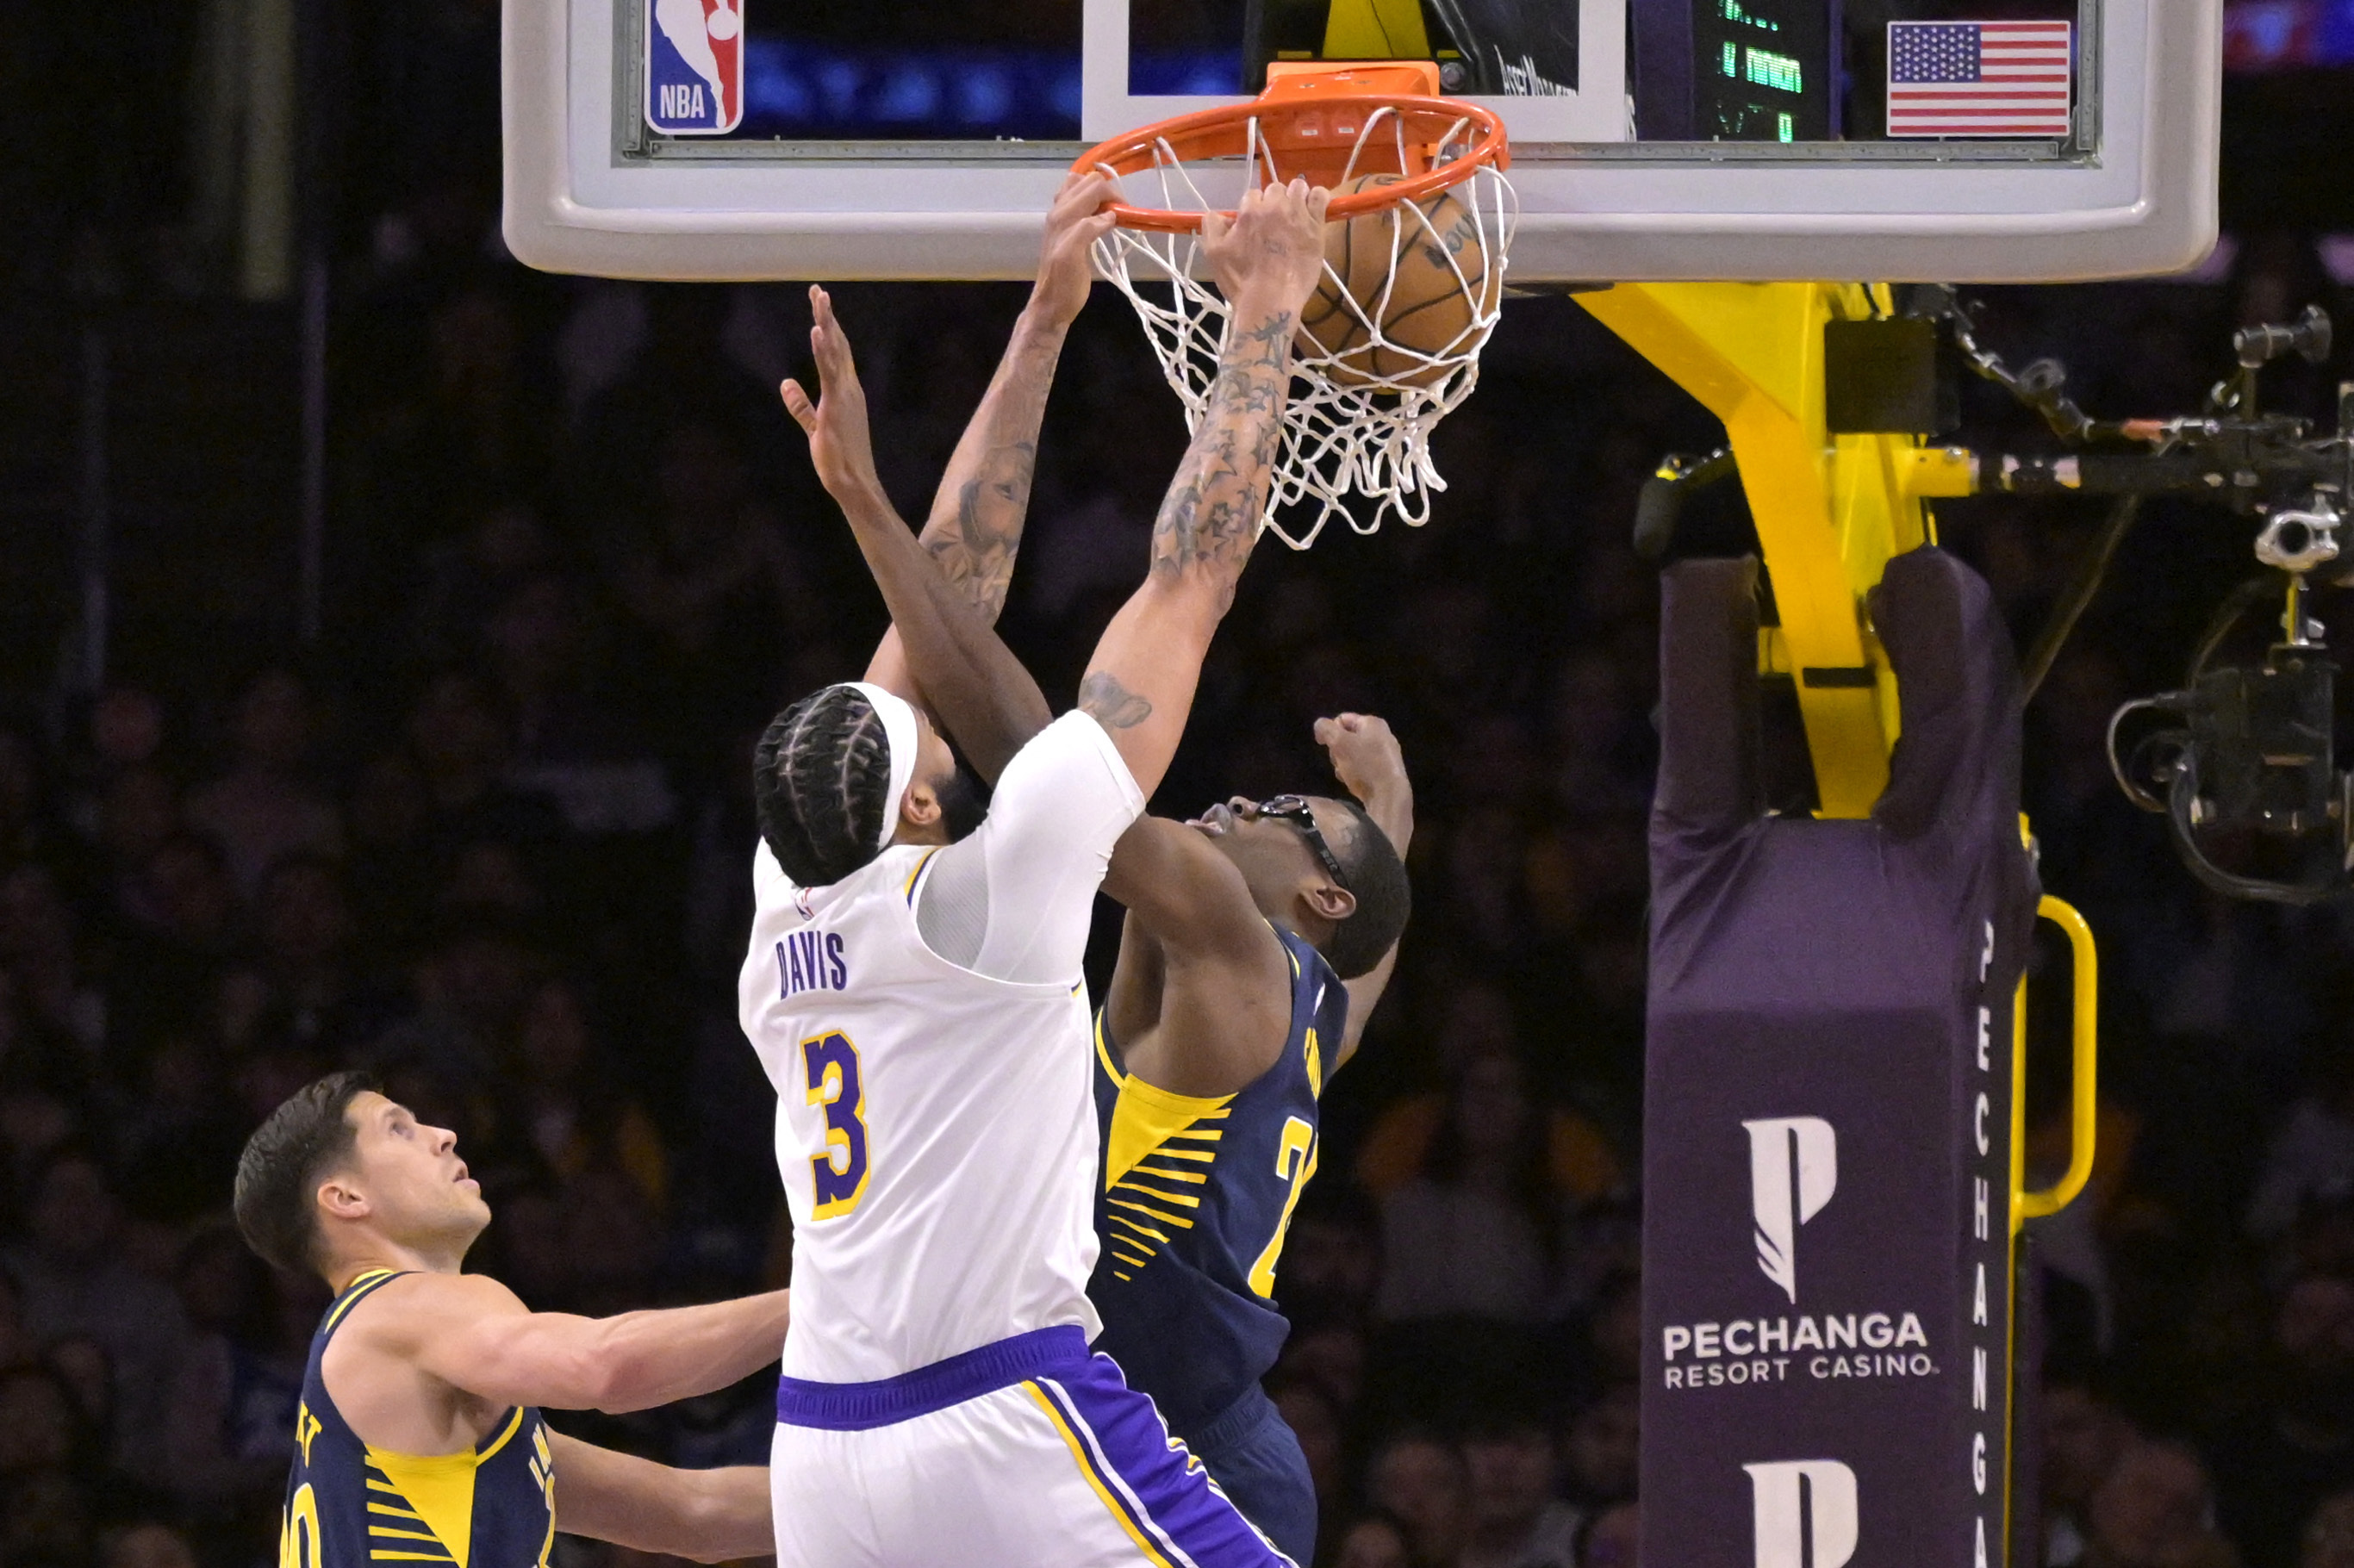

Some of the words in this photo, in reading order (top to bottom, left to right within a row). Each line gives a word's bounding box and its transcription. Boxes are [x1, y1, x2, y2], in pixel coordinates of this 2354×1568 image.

[660, 84, 705, 119] NBA
[776, 930, 848, 999] DAVIS
[800, 1028, 871, 1222] 3
[1663, 1312, 1928, 1361] PECHANGA
[1665, 1359, 1790, 1389] RESORT
[1809, 1353, 1932, 1378] CASINO
